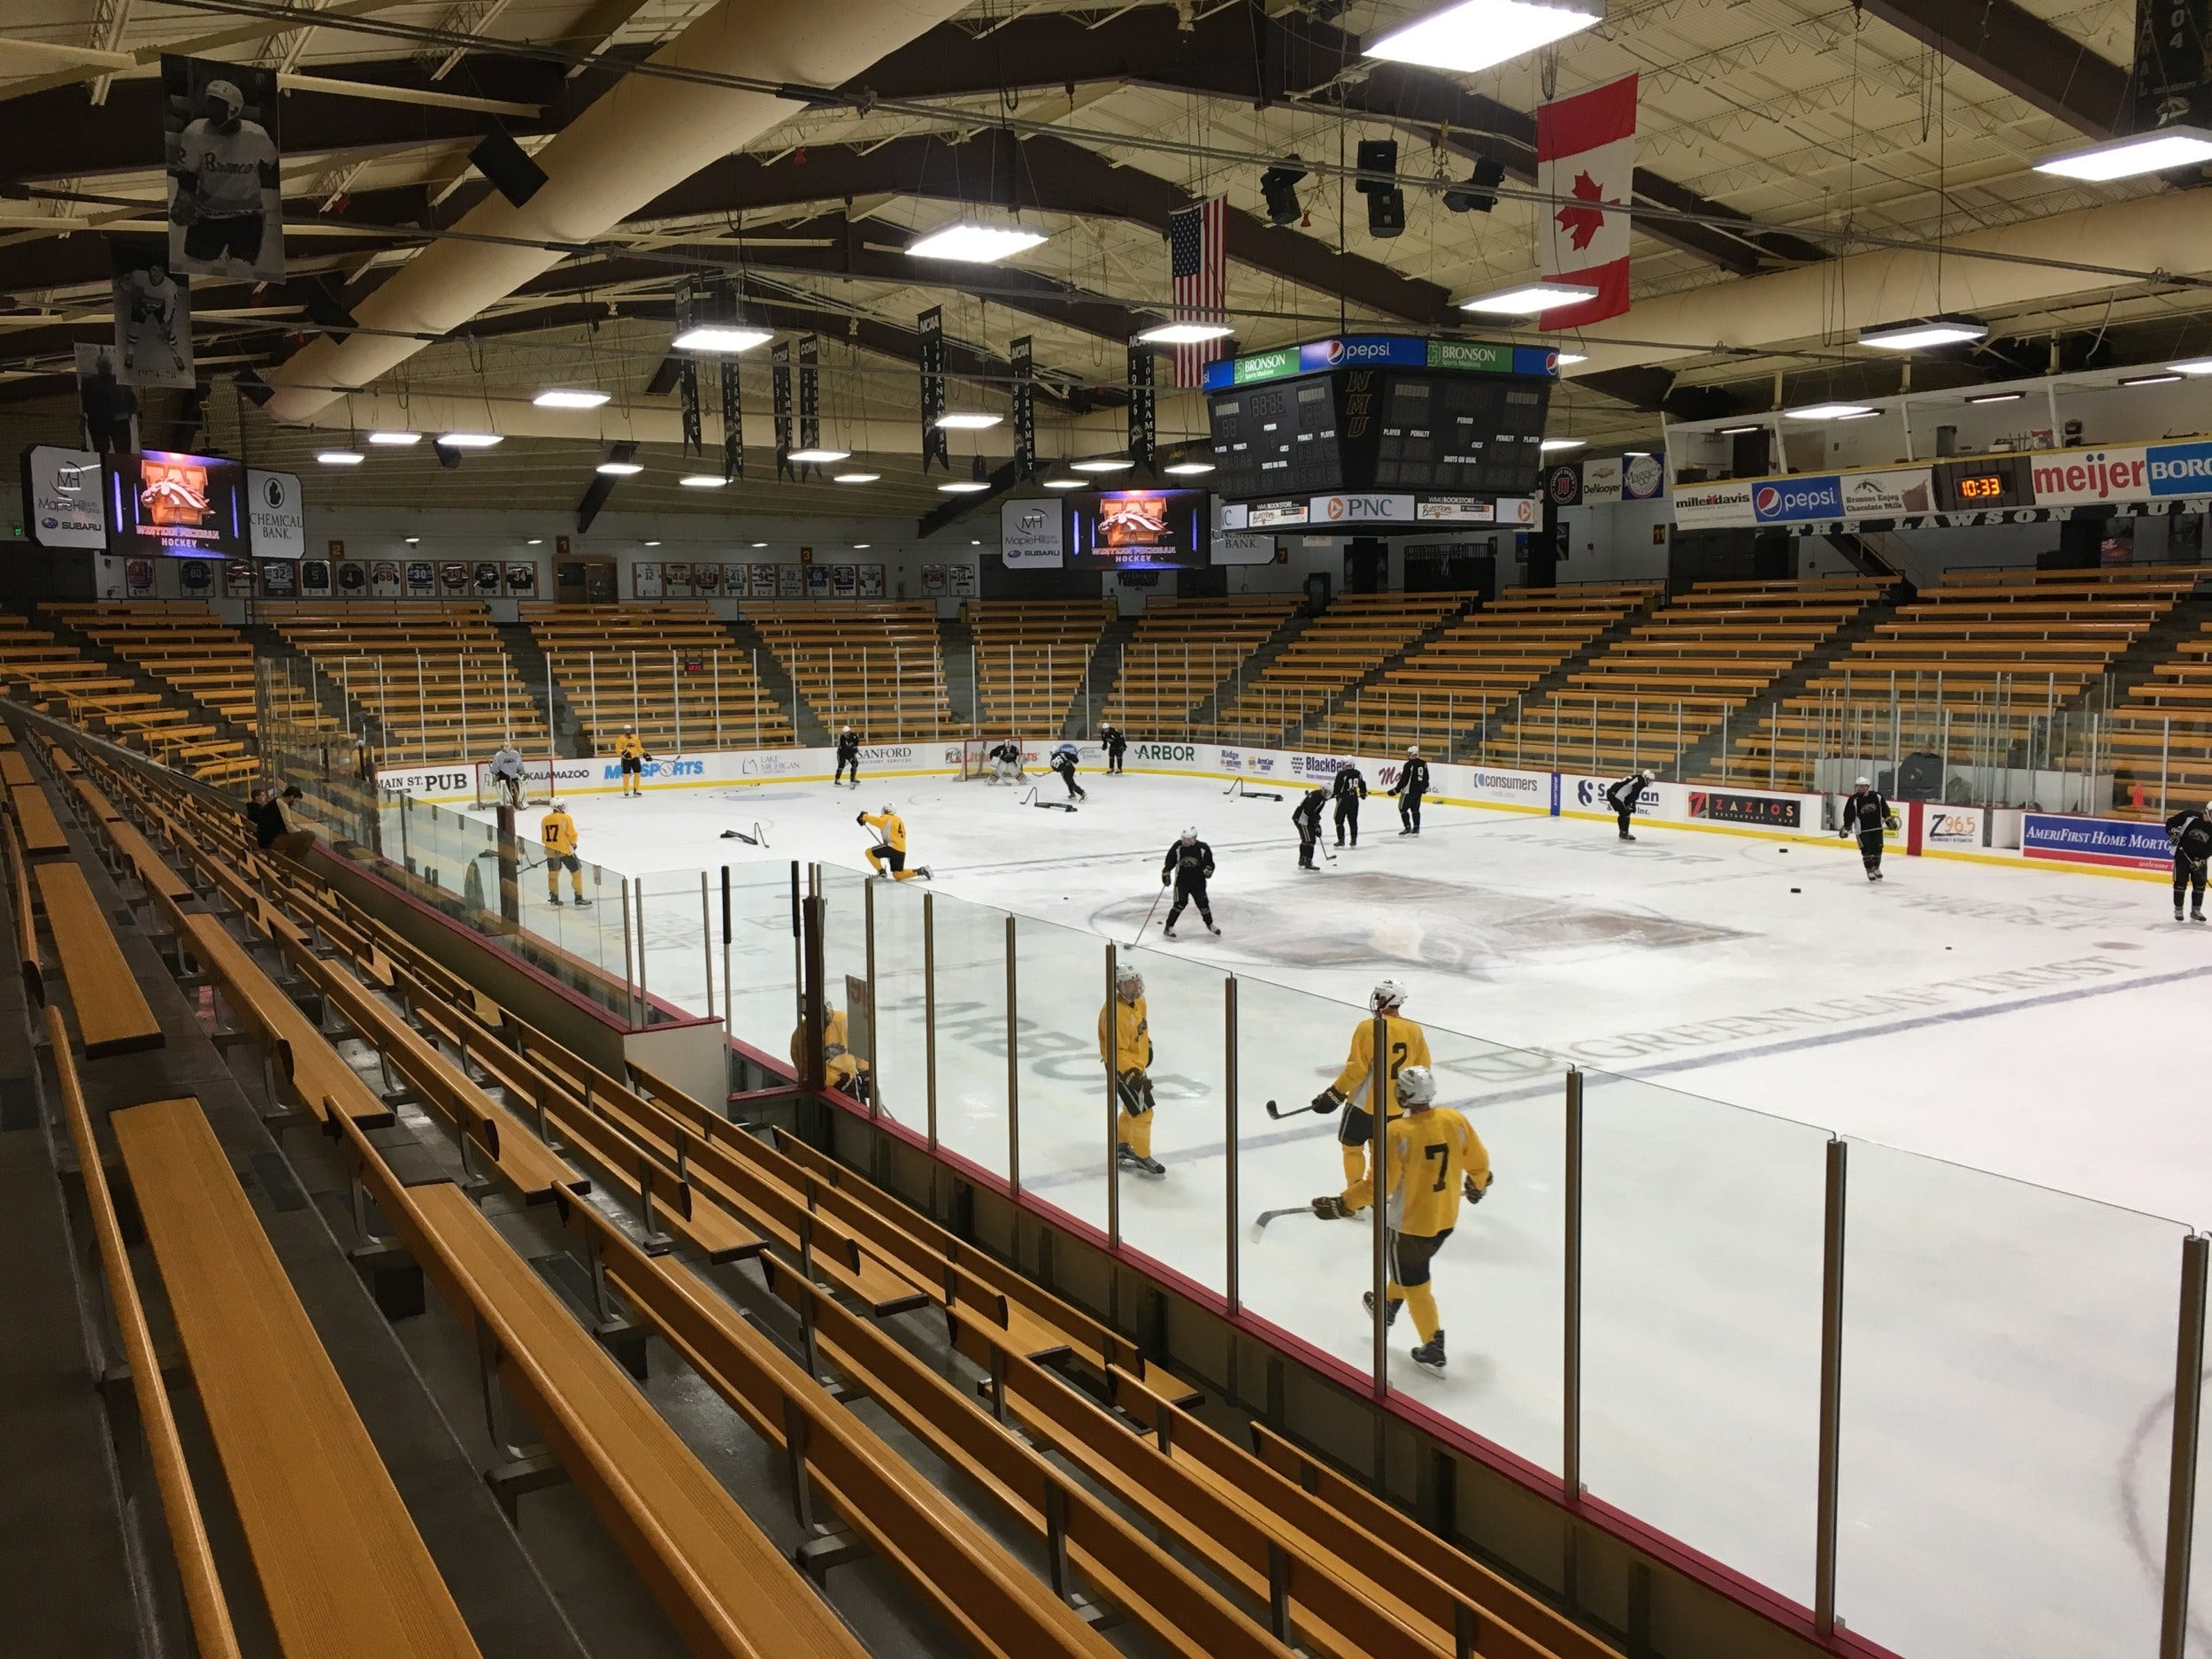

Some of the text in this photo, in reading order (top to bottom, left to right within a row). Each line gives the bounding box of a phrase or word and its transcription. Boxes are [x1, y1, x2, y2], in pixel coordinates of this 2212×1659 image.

[919, 314, 940, 334] NCAA
[1011, 342, 1030, 360] NCAA
[1346, 342, 1391, 360] pepsi
[1441, 345, 1496, 362] BRONSON
[1244, 354, 1286, 373] BRONSON
[935, 340, 946, 453] TOURNANT
[1144, 356, 1154, 462] TOURNAMENT
[2033, 452, 2145, 498] meijer
[1583, 483, 1621, 495] DeNooyer
[1960, 478, 2001, 497] 10:33
[1784, 487, 1835, 512] pepsi
[1846, 502, 1903, 512] Chocolate Milk
[1878, 494, 1900, 503] Enjoy
[1346, 498, 1393, 518] PNC
[1892, 498, 2210, 532] LAWSON LUN
[61, 520, 102, 532] SUBARU
[249, 511, 303, 528] CHEMICAL
[160, 537, 197, 548] HOCKEY
[803, 550, 811, 560] 3
[857, 747, 912, 760] SANFORD
[1134, 744, 1194, 762] ARBOR
[1221, 749, 1240, 761] Ridge
[1306, 756, 1356, 773] BlackBe
[407, 775, 423, 787] ST.
[424, 772, 468, 792] PUB
[527, 769, 590, 780] KALAMAZOO
[1485, 775, 1538, 792] consumers
[1637, 806, 1651, 816] Inc.
[1715, 799, 1794, 818] ZAZIOS
[545, 824, 560, 842] 17
[2090, 830, 2128, 848] HOME
[2127, 833, 2173, 851] MORTG
[2138, 860, 2170, 870] welcome
[1941, 954, 2147, 1001] TRUST
[1390, 1041, 1409, 1080] 2
[1424, 1142, 1450, 1194] 7
